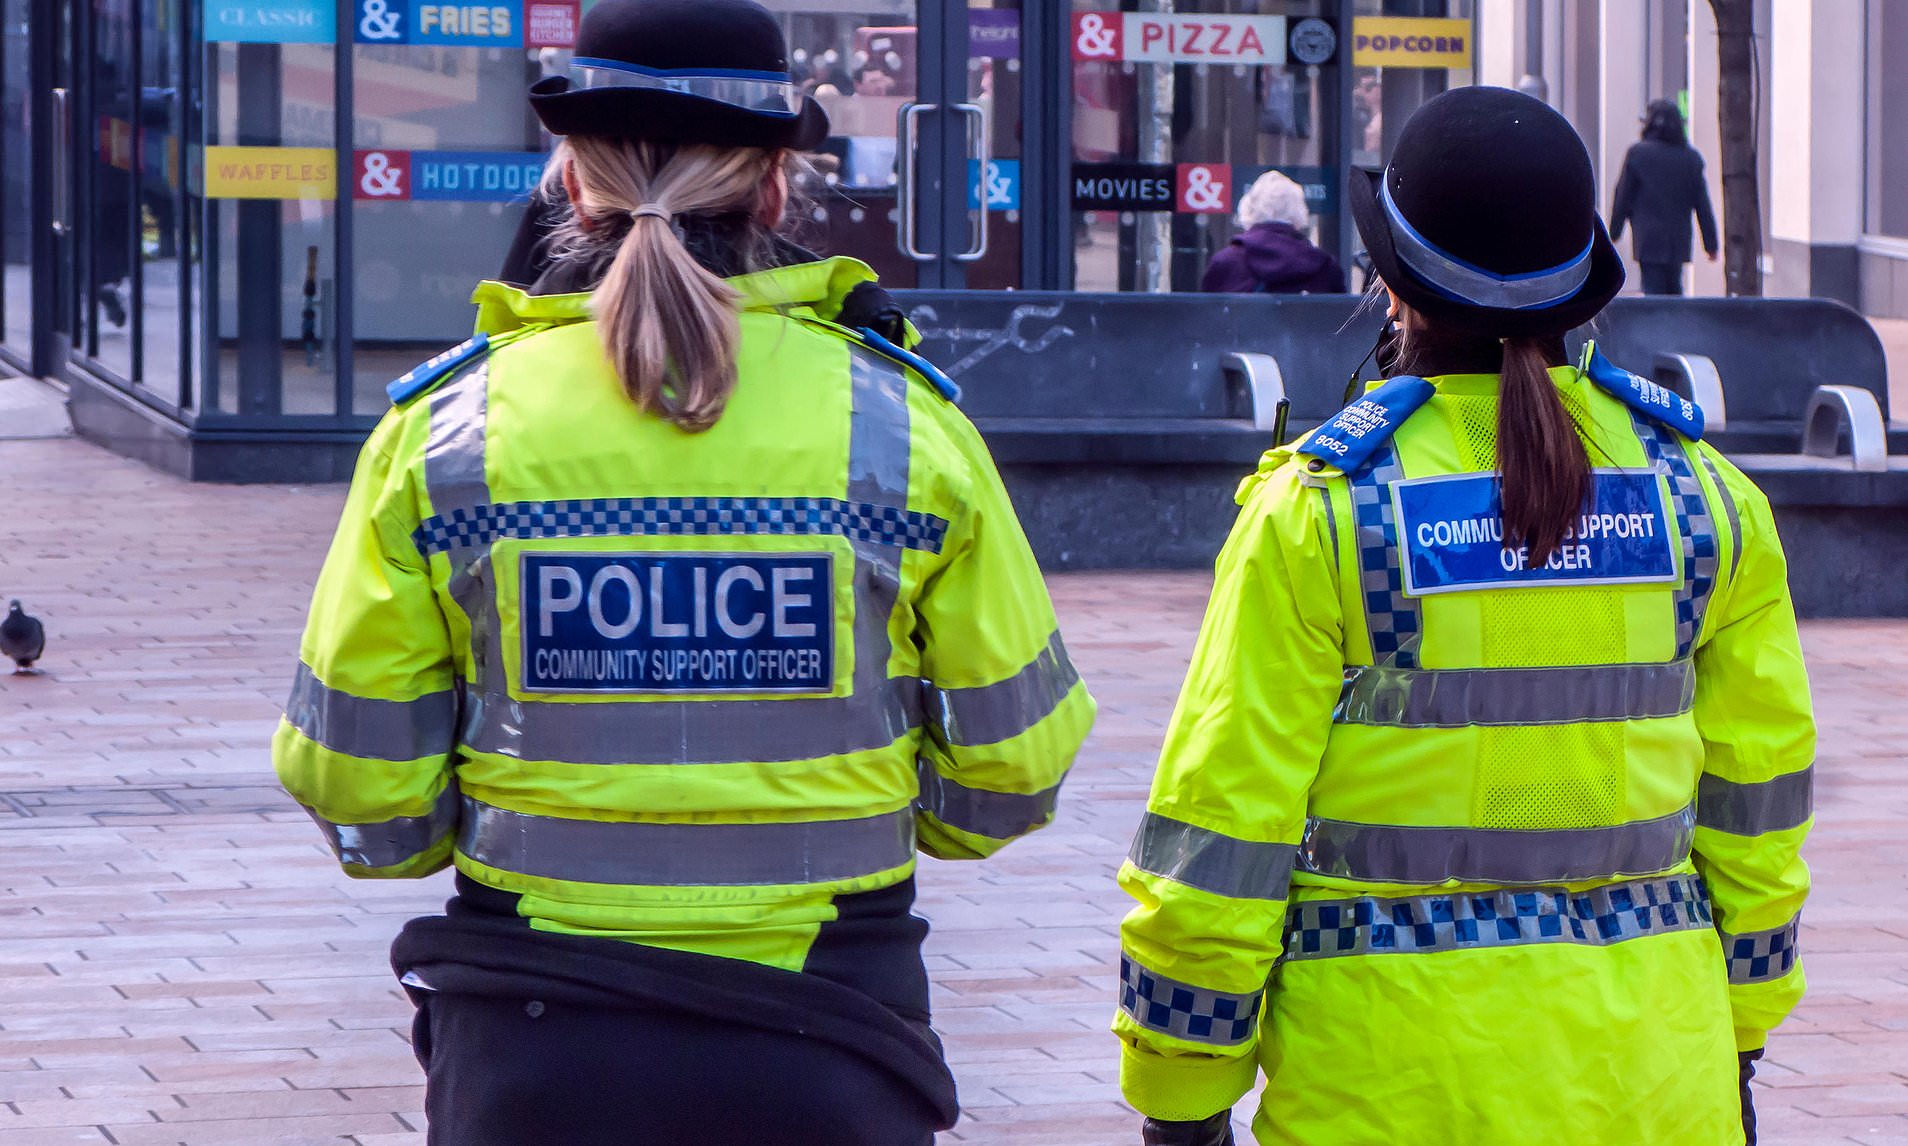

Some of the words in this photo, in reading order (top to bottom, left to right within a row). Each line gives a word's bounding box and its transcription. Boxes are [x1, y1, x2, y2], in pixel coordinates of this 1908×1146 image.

[219, 7, 322, 26] CLASSIC
[359, 0, 401, 39] &
[419, 5, 512, 37] FRIES
[1077, 13, 1116, 56] &
[1141, 22, 1265, 55] PIZZA
[1355, 35, 1464, 53] POPCORN
[218, 163, 328, 182] WAFFLES
[361, 152, 402, 196] &
[1075, 178, 1171, 200] MOVIES
[1184, 166, 1224, 210] &
[1343, 406, 1390, 429] COMMUNITY
[1358, 400, 1389, 417] POLICE
[1332, 420, 1366, 440] OFFICER
[1339, 412, 1377, 433] SUPPORT
[1314, 434, 1349, 457] 8052
[1416, 517, 1504, 548] COMMU
[1500, 544, 1592, 572] OFCER
[538, 564, 817, 640] POLICE
[535, 648, 646, 681] COMMUNITY
[651, 648, 737, 681] SUPPORT
[742, 648, 822, 681] OFFICER
